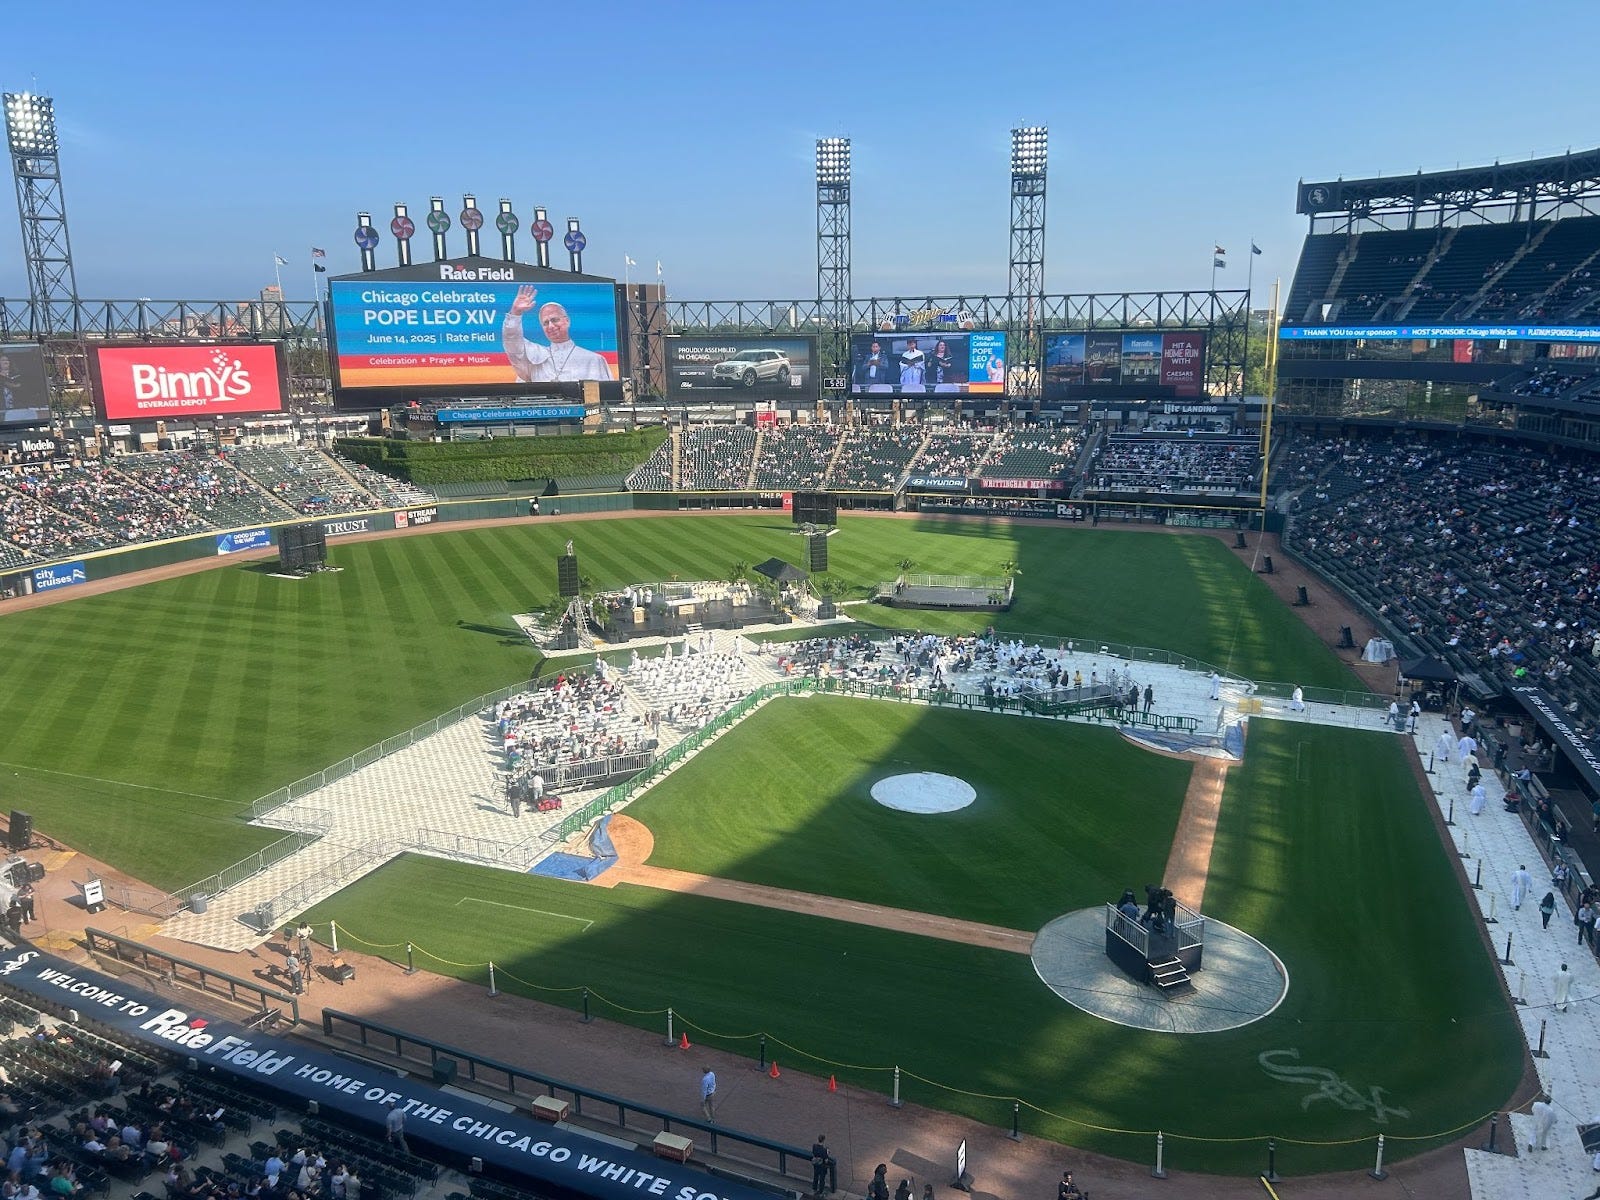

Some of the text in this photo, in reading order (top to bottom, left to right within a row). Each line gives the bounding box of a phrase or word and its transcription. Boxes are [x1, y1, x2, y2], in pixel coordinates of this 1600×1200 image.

[440, 264, 514, 280] Rate Field
[361, 290, 496, 306] Chicago Celebrates
[364, 309, 497, 325] POPE LEO XIV
[367, 332, 496, 344] June 14, 2025 Rate Field
[1412, 328, 1431, 336] HOST
[1466, 328, 1489, 337] Chicago
[1489, 328, 1506, 336] White
[1506, 328, 1518, 336] Sox
[1165, 348, 1199, 358] HOME RUN
[370, 357, 417, 365] Celebration
[429, 356, 456, 365] Prayer
[972, 362, 985, 370] XIV
[138, 398, 207, 409] BEVERAGE DEPOT
[1182, 405, 1218, 413] LANDING
[452, 411, 481, 420] Chicago
[482, 410, 520, 418] Celebrates
[22, 439, 55, 451] Modelo
[926, 479, 963, 487] HYUNDAI
[982, 479, 1052, 489] WHITTINGHAM MEATS
[408, 508, 437, 519] STREAM
[414, 515, 432, 524] NOW
[323, 519, 368, 534] TRUST
[36, 569, 54, 580] city
[36, 575, 72, 588] cruises
[37, 968, 125, 1007] WELCOME
[118, 1000, 149, 1016] TO
[139, 1008, 214, 1049] Rate
[204, 1035, 295, 1075] Field
[294, 1063, 367, 1095] HOME
[364, 1087, 402, 1105] OF
[402, 1098, 453, 1124] THE
[452, 1116, 571, 1162] CHICAGO
[577, 1154, 672, 1195] WHITE
